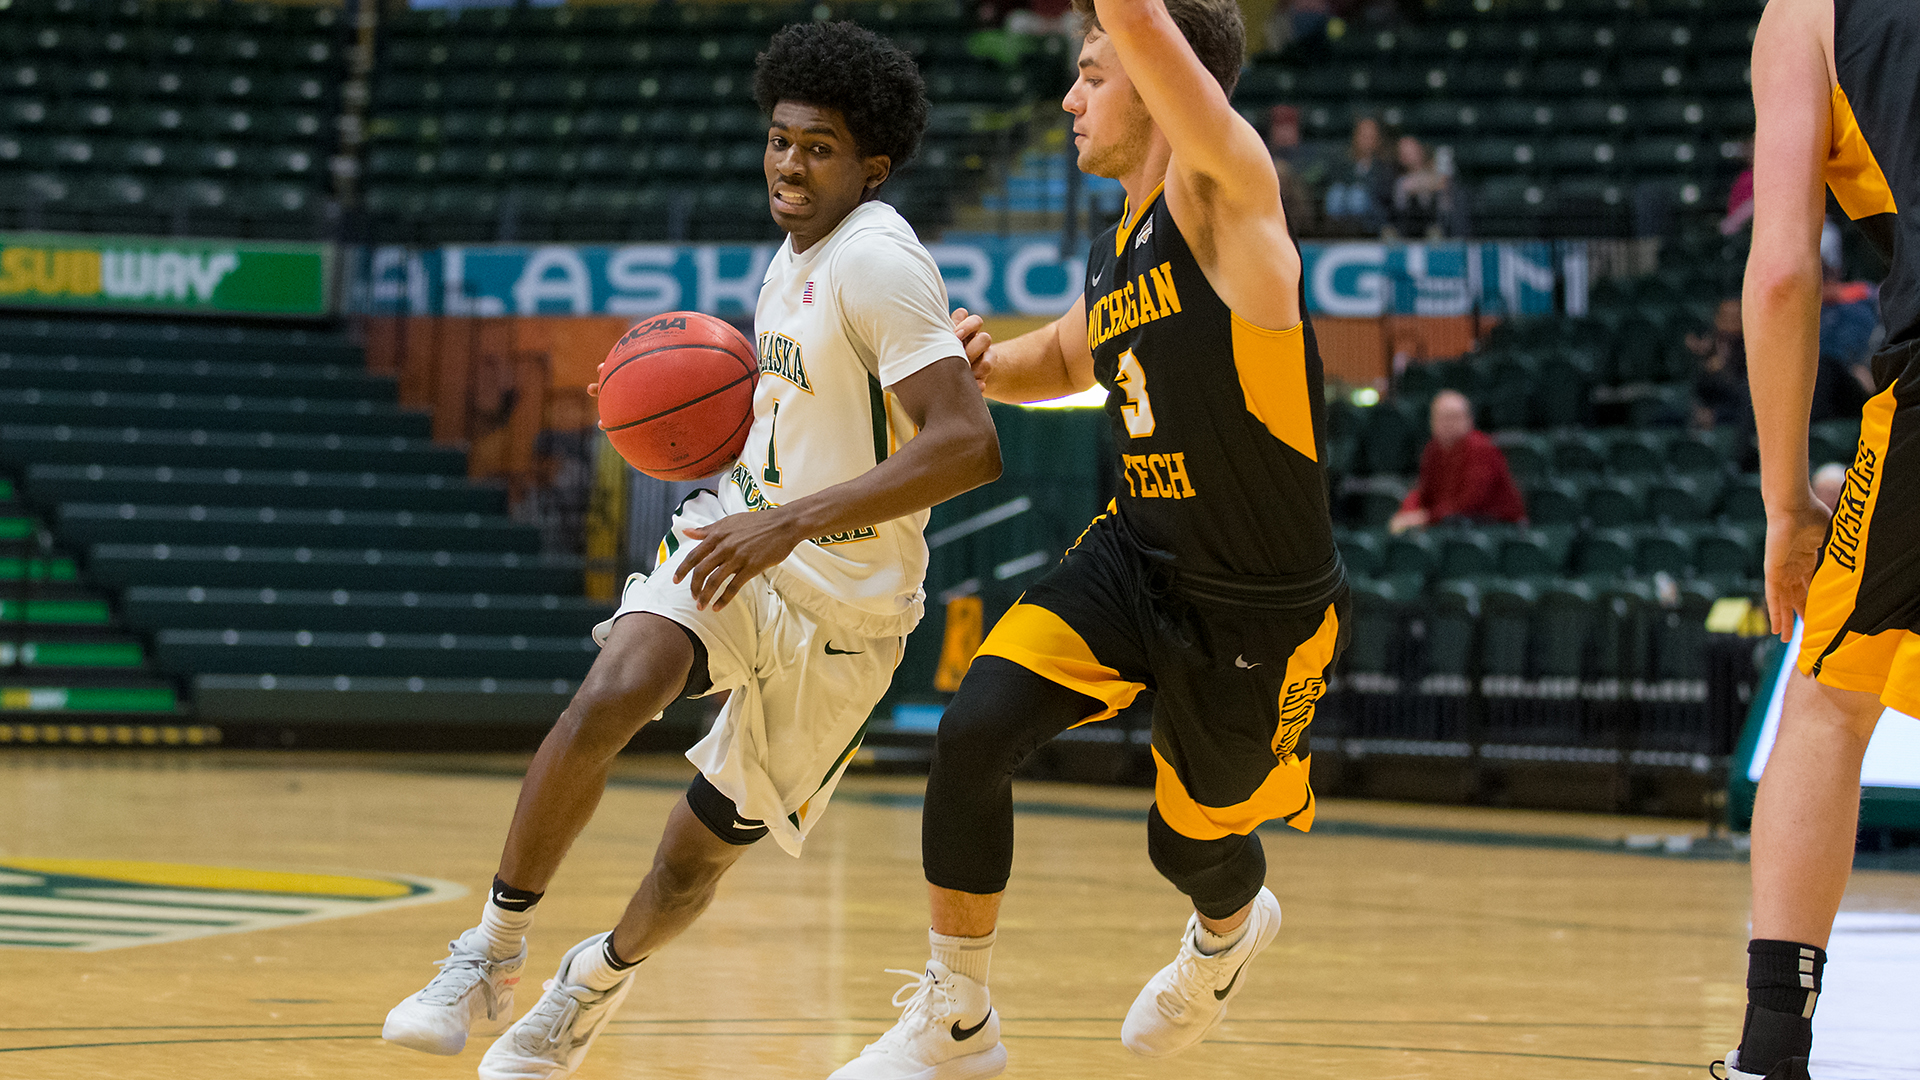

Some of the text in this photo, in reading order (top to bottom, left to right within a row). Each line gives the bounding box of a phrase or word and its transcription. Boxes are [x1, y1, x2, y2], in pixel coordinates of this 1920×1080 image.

[0, 248, 239, 299] SUBWAY
[368, 244, 772, 316] ALASK
[614, 317, 687, 354] NCAA
[1114, 347, 1155, 438] 3
[763, 398, 783, 488] 1
[1122, 452, 1196, 499] TECH
[1829, 439, 1877, 573] HUSKIES
